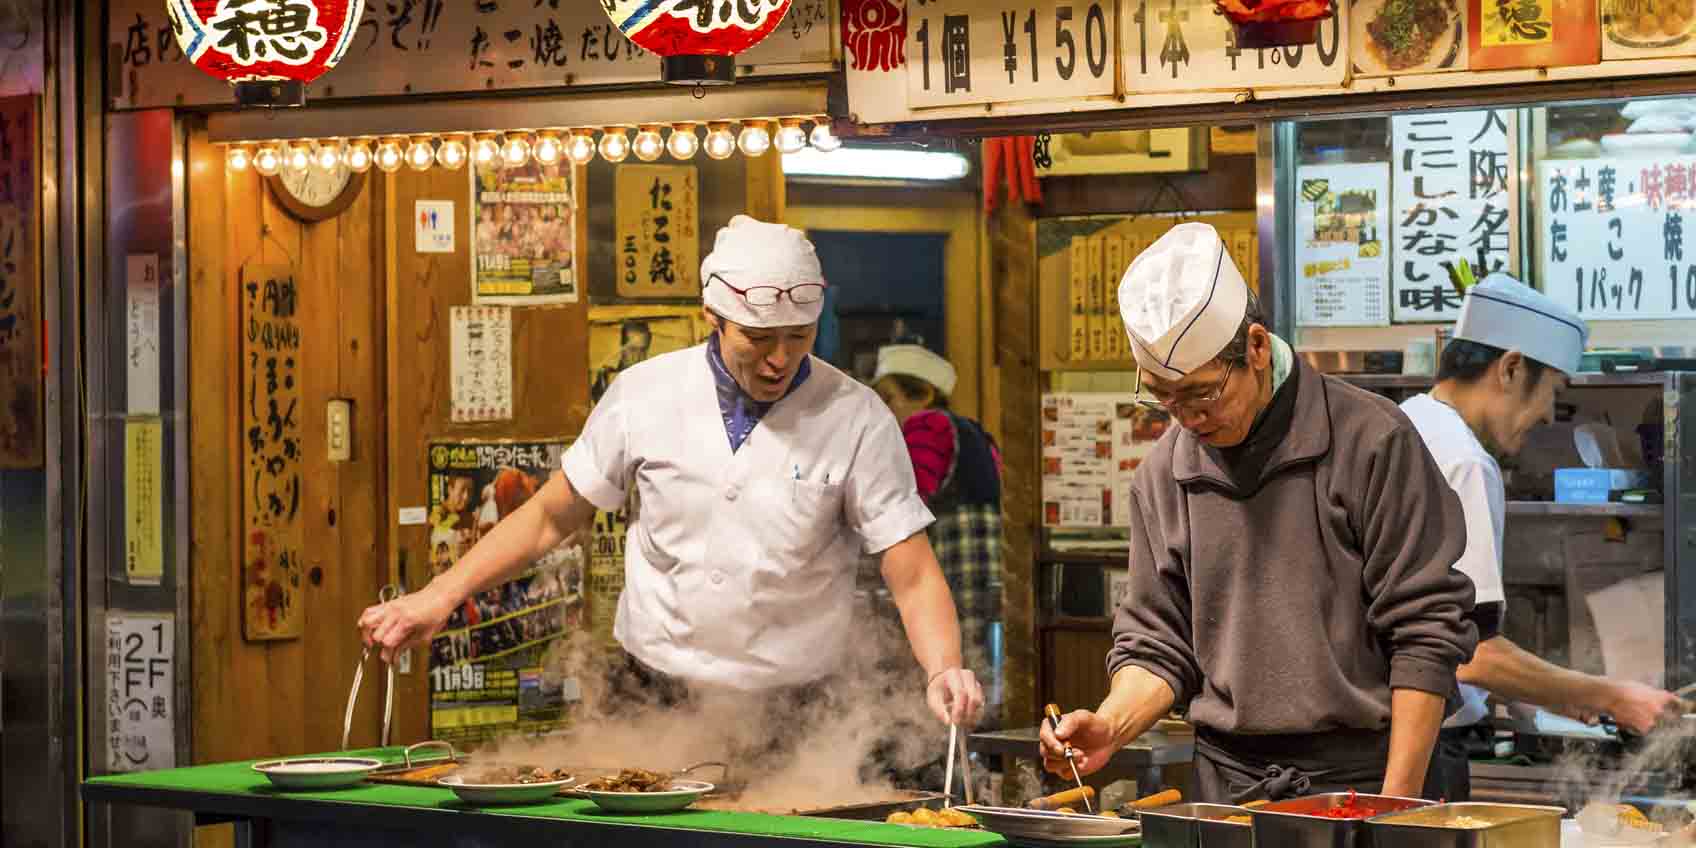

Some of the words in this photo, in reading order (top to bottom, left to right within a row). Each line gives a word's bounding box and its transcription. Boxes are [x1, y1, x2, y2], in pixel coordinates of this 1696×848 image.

[469, 18, 567, 71] たこ焼
[916, 14, 971, 94] 1個
[1001, 3, 1107, 84] ¥150
[1133, 1, 1190, 79] 1本
[648, 175, 675, 285] たこ焼
[1550, 211, 1683, 263] たこ焼
